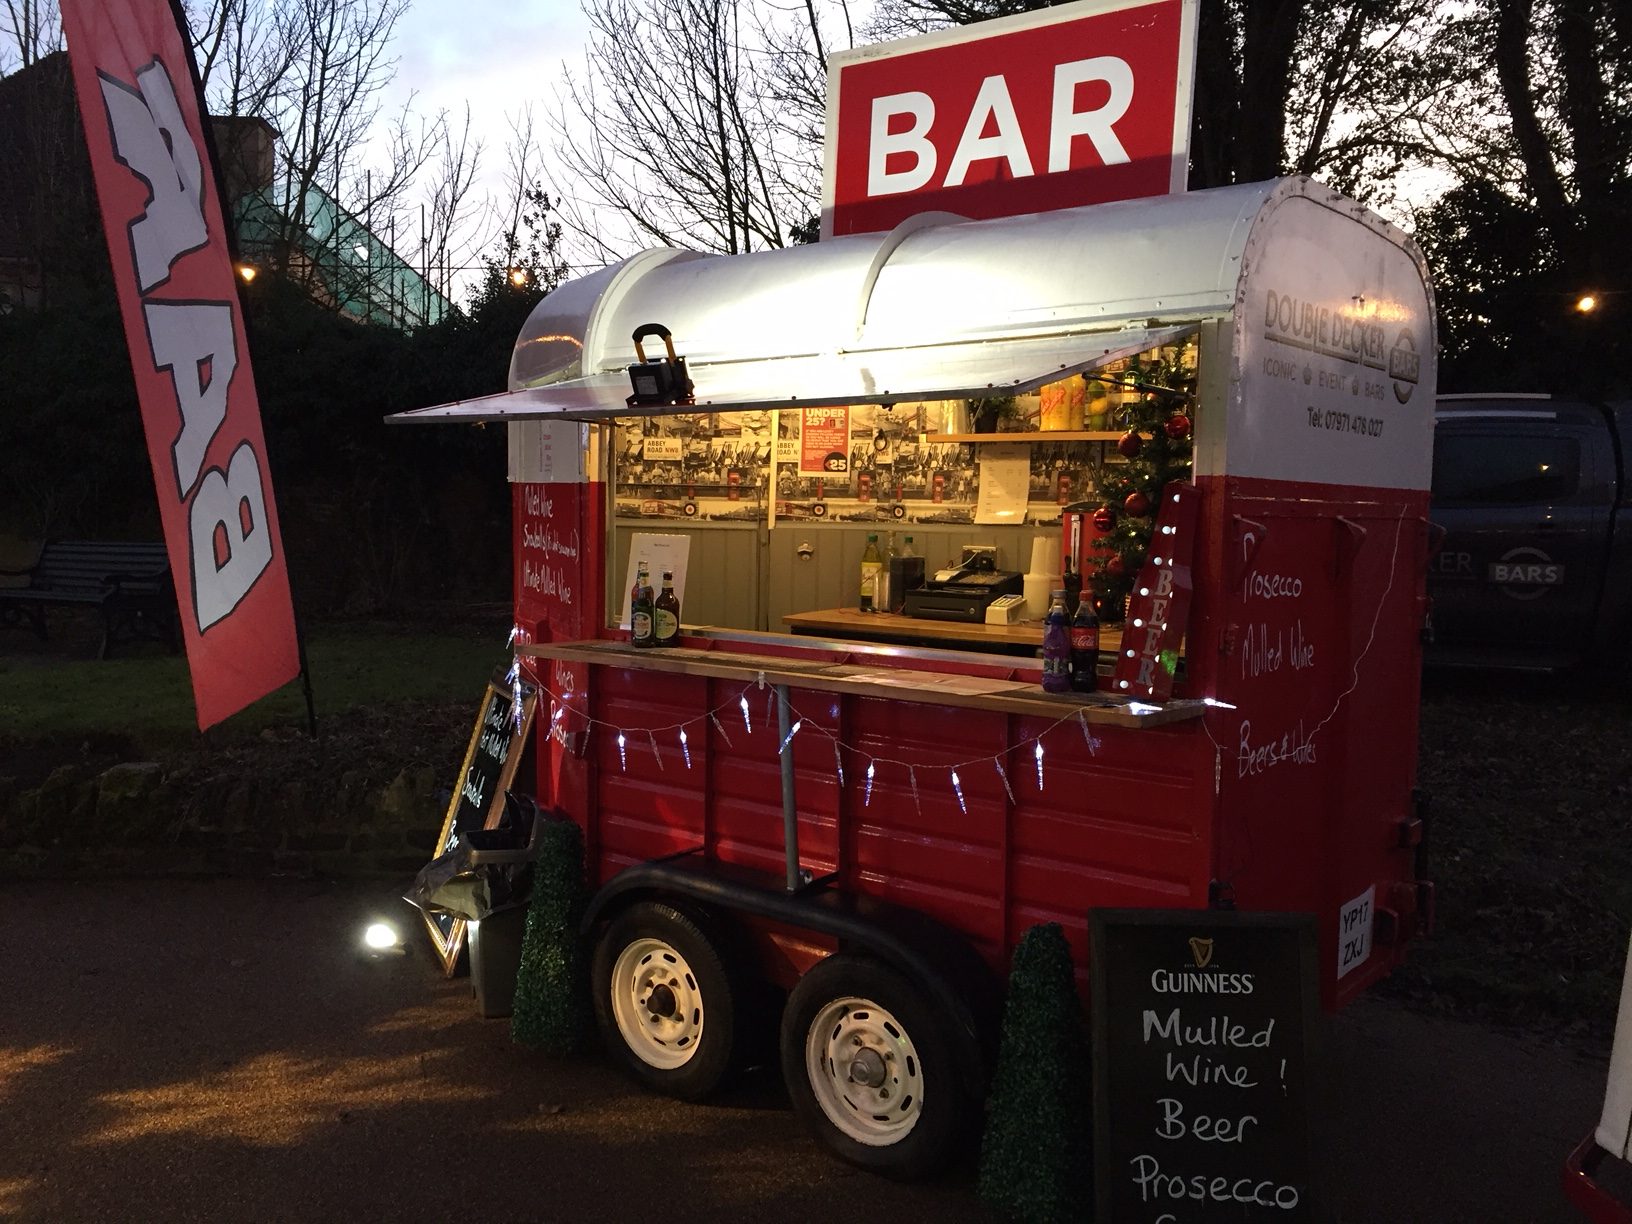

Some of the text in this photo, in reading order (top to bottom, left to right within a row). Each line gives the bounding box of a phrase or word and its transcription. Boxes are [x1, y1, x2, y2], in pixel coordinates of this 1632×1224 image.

[867, 55, 1135, 197] BAR
[1265, 289, 1385, 364] DOUBLE DECKER
[1263, 357, 1385, 400] ICONIC EVENT BARS
[805, 408, 845, 418] UNDER
[805, 417, 826, 426] 25?
[1325, 410, 1350, 433] 07971
[1368, 418, 1384, 437] 027
[1430, 551, 1559, 583] ER BARS
[1136, 569, 1174, 689] BEER
[1242, 623, 1283, 681] Mulled
[1238, 719, 1277, 778] Beers
[1343, 900, 1369, 933] YP17
[1343, 934, 1364, 966] ZXJ
[1151, 969, 1254, 994] GUINNESS
[1142, 1008, 1275, 1047] Mulled
[1166, 1052, 1258, 1088] Wine
[1155, 1098, 1258, 1143] Beer
[1130, 1154, 1299, 1210] Prosecco
